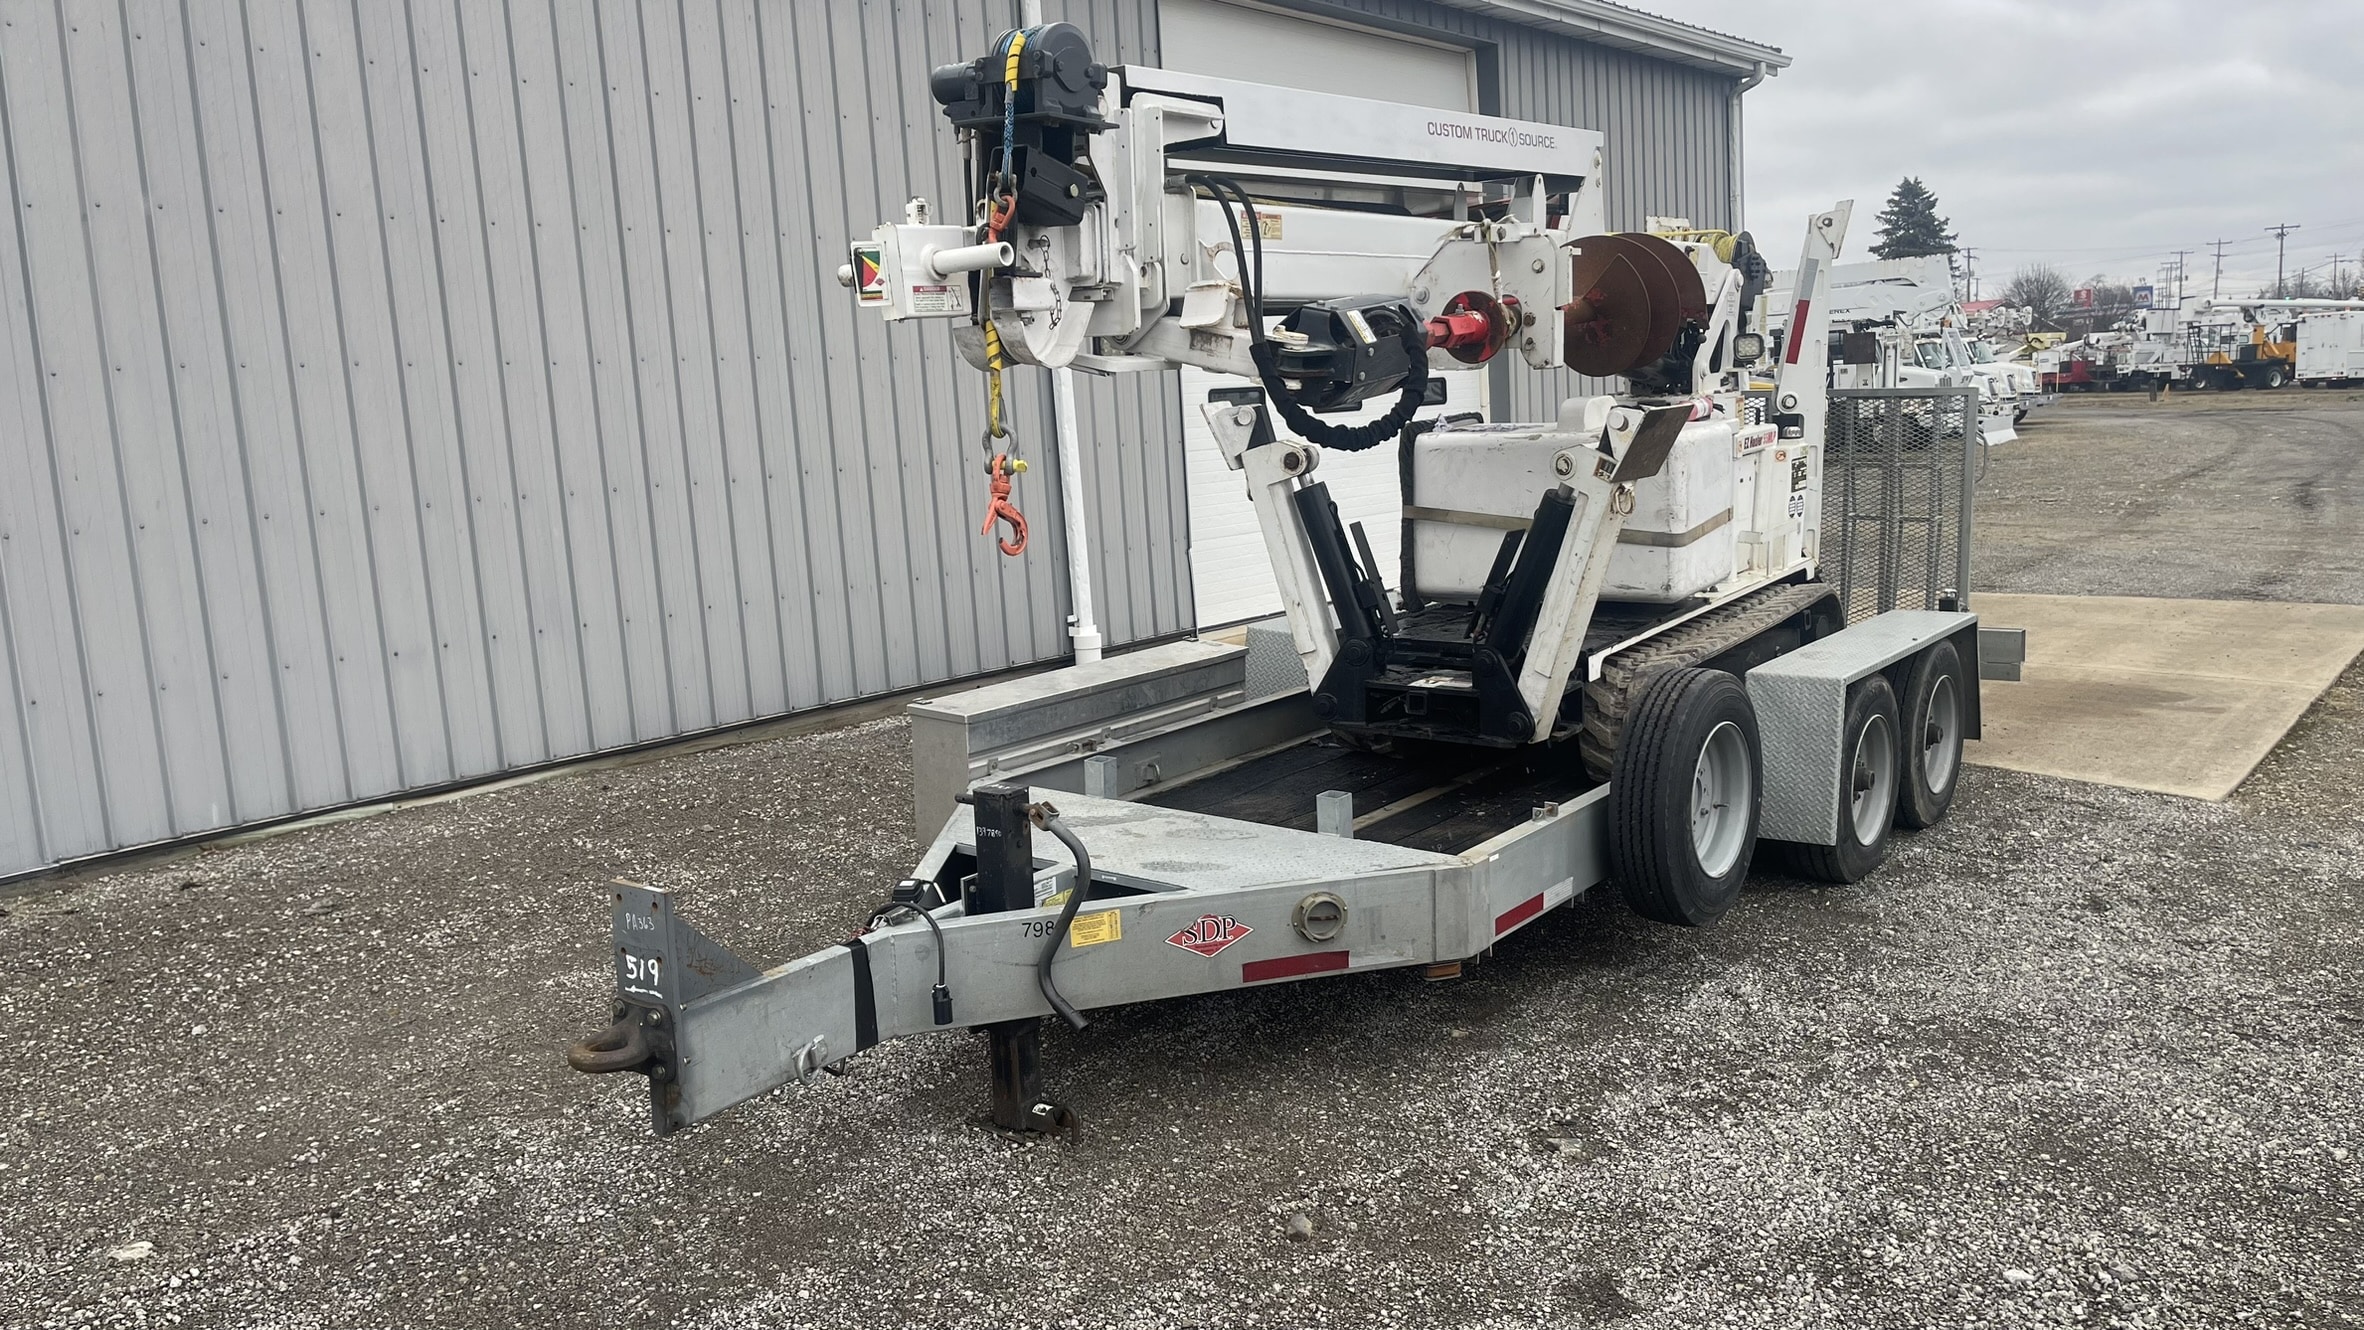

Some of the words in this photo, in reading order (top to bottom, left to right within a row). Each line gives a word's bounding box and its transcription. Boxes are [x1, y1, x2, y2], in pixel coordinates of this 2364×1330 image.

[1427, 121, 1472, 140] CUSTOM
[1475, 127, 1508, 144] TRUCK
[1519, 132, 1556, 149] SOURCE
[625, 954, 659, 986] 519
